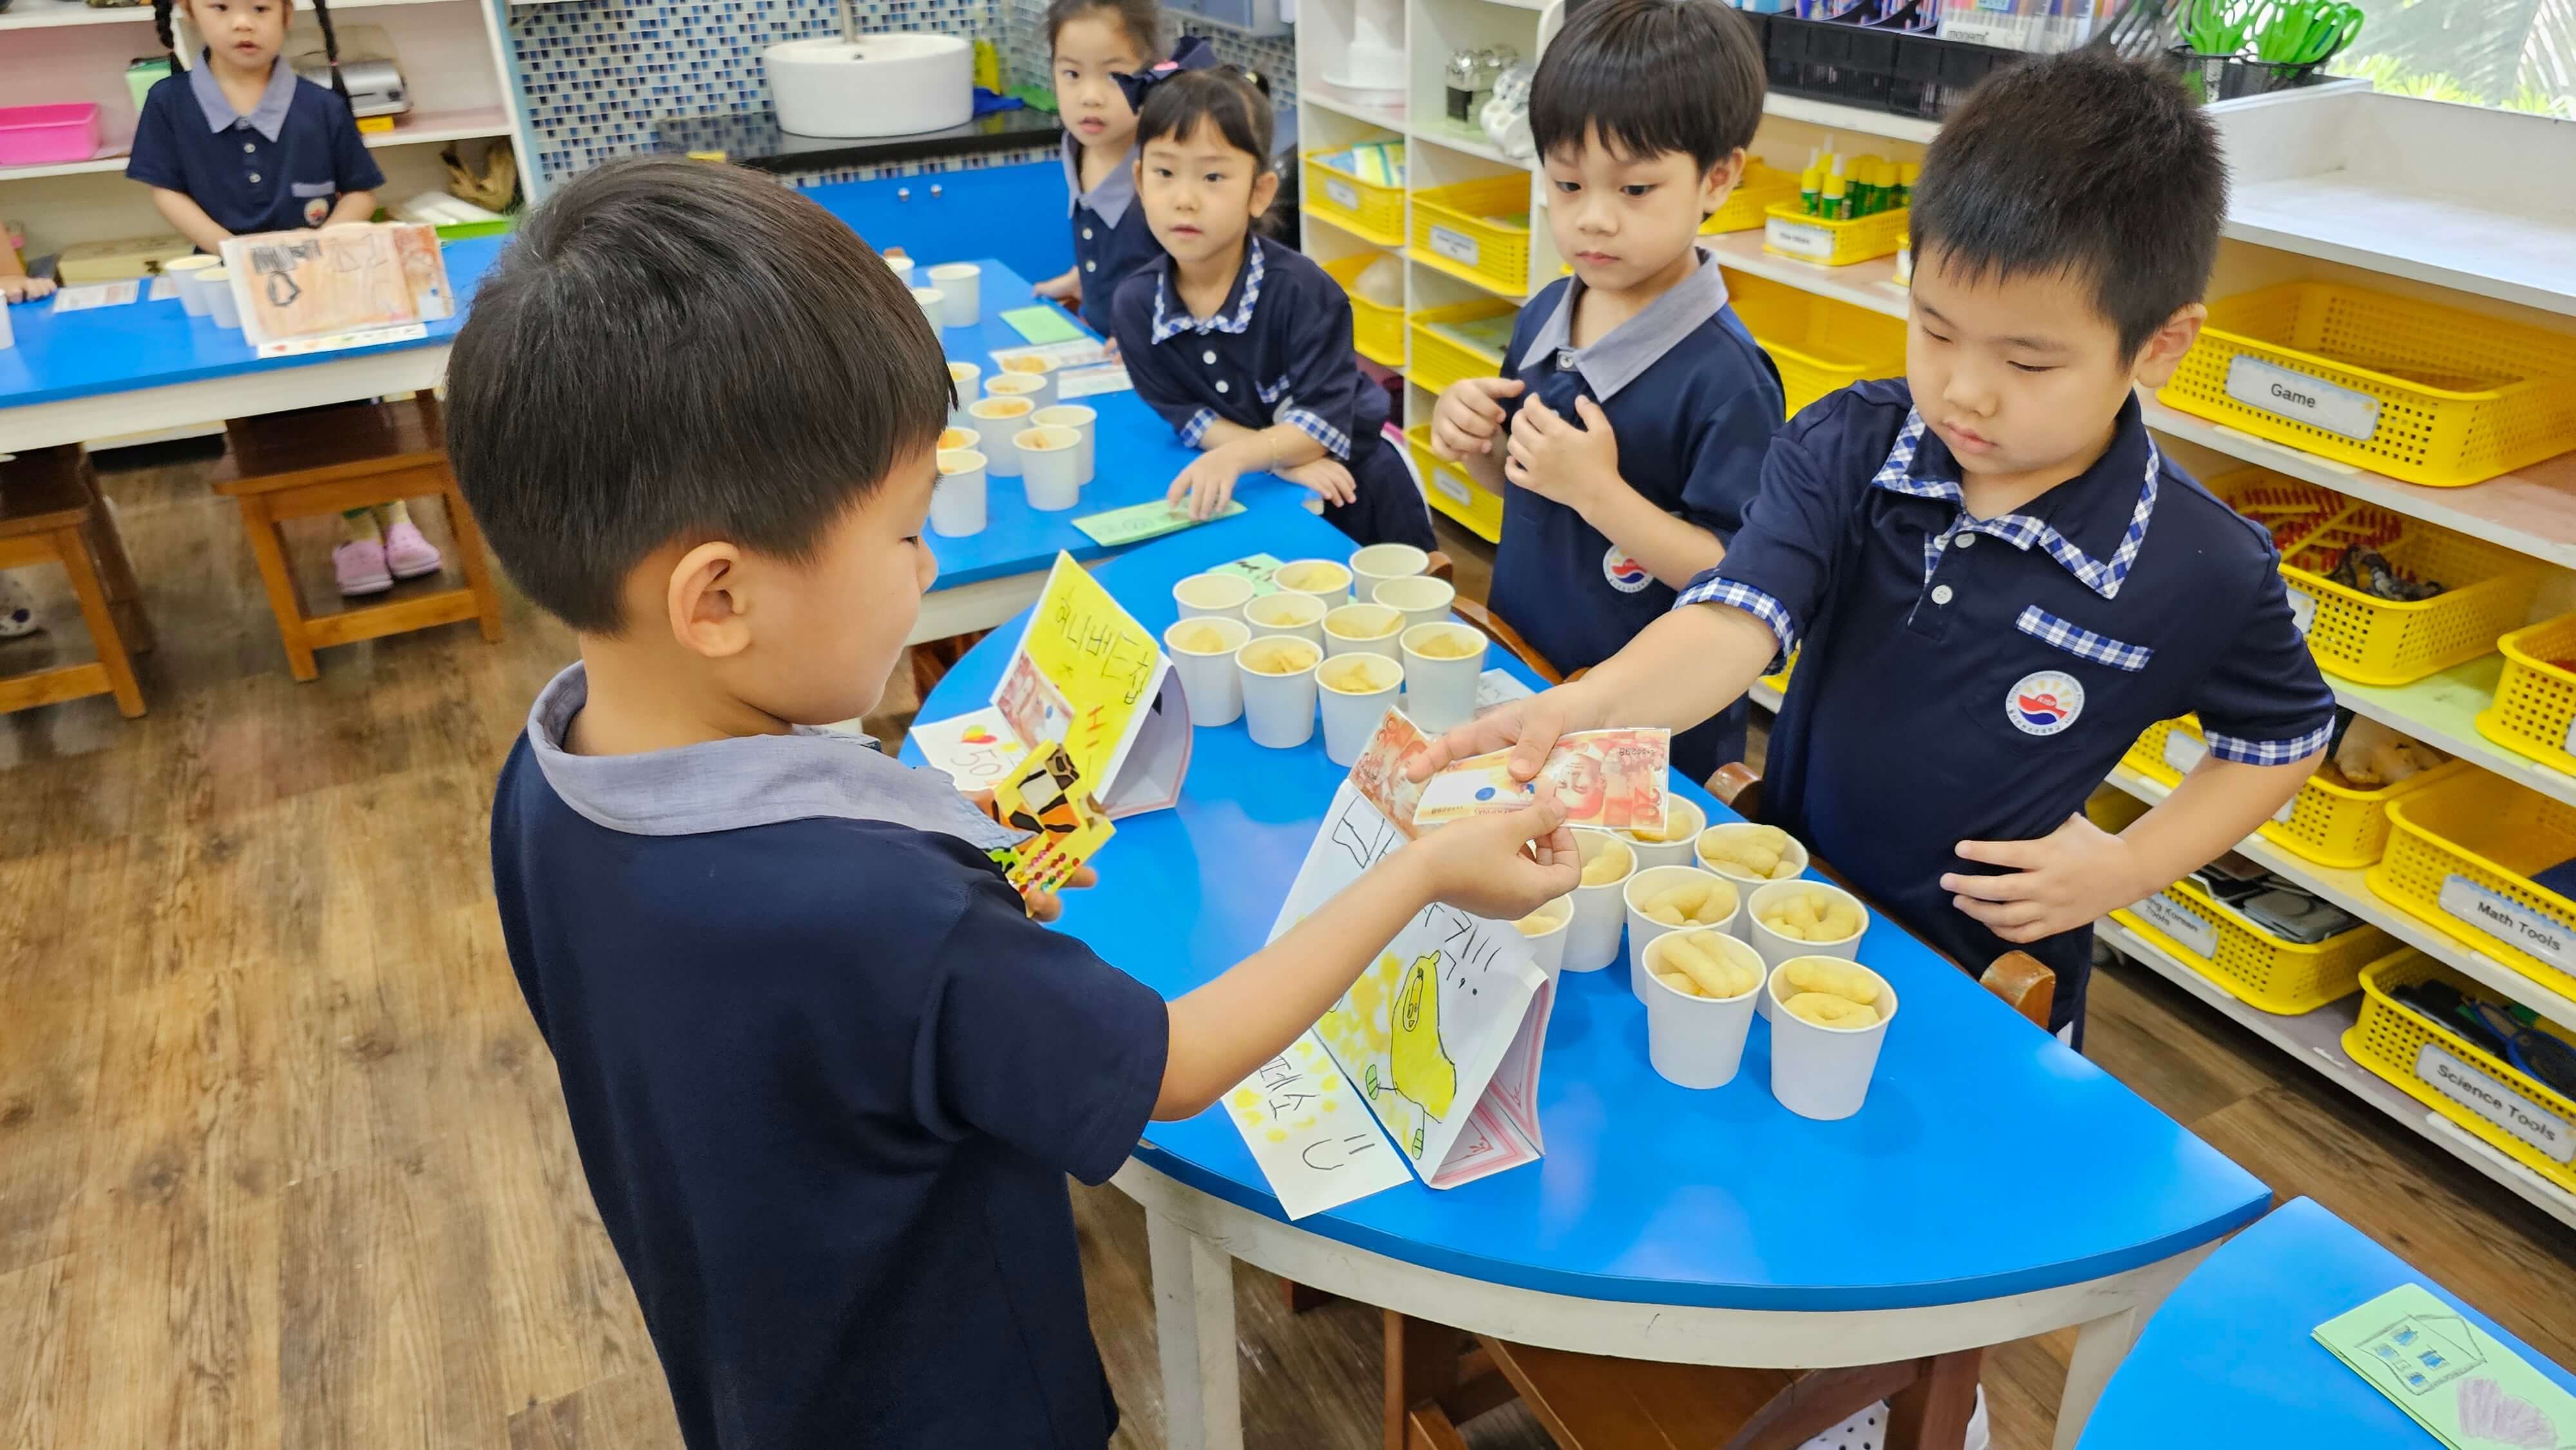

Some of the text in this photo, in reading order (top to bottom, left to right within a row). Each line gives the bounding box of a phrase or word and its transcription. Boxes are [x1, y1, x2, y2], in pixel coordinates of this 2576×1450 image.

[2270, 382, 2316, 408] Game
[950, 749, 1003, 776] 50
[1633, 787, 1661, 821] 20
[2146, 905, 2170, 926] Tools
[2164, 907, 2199, 932] Korean
[2477, 901, 2561, 951] Math Tools
[2437, 1064, 2556, 1142] Science Tools
